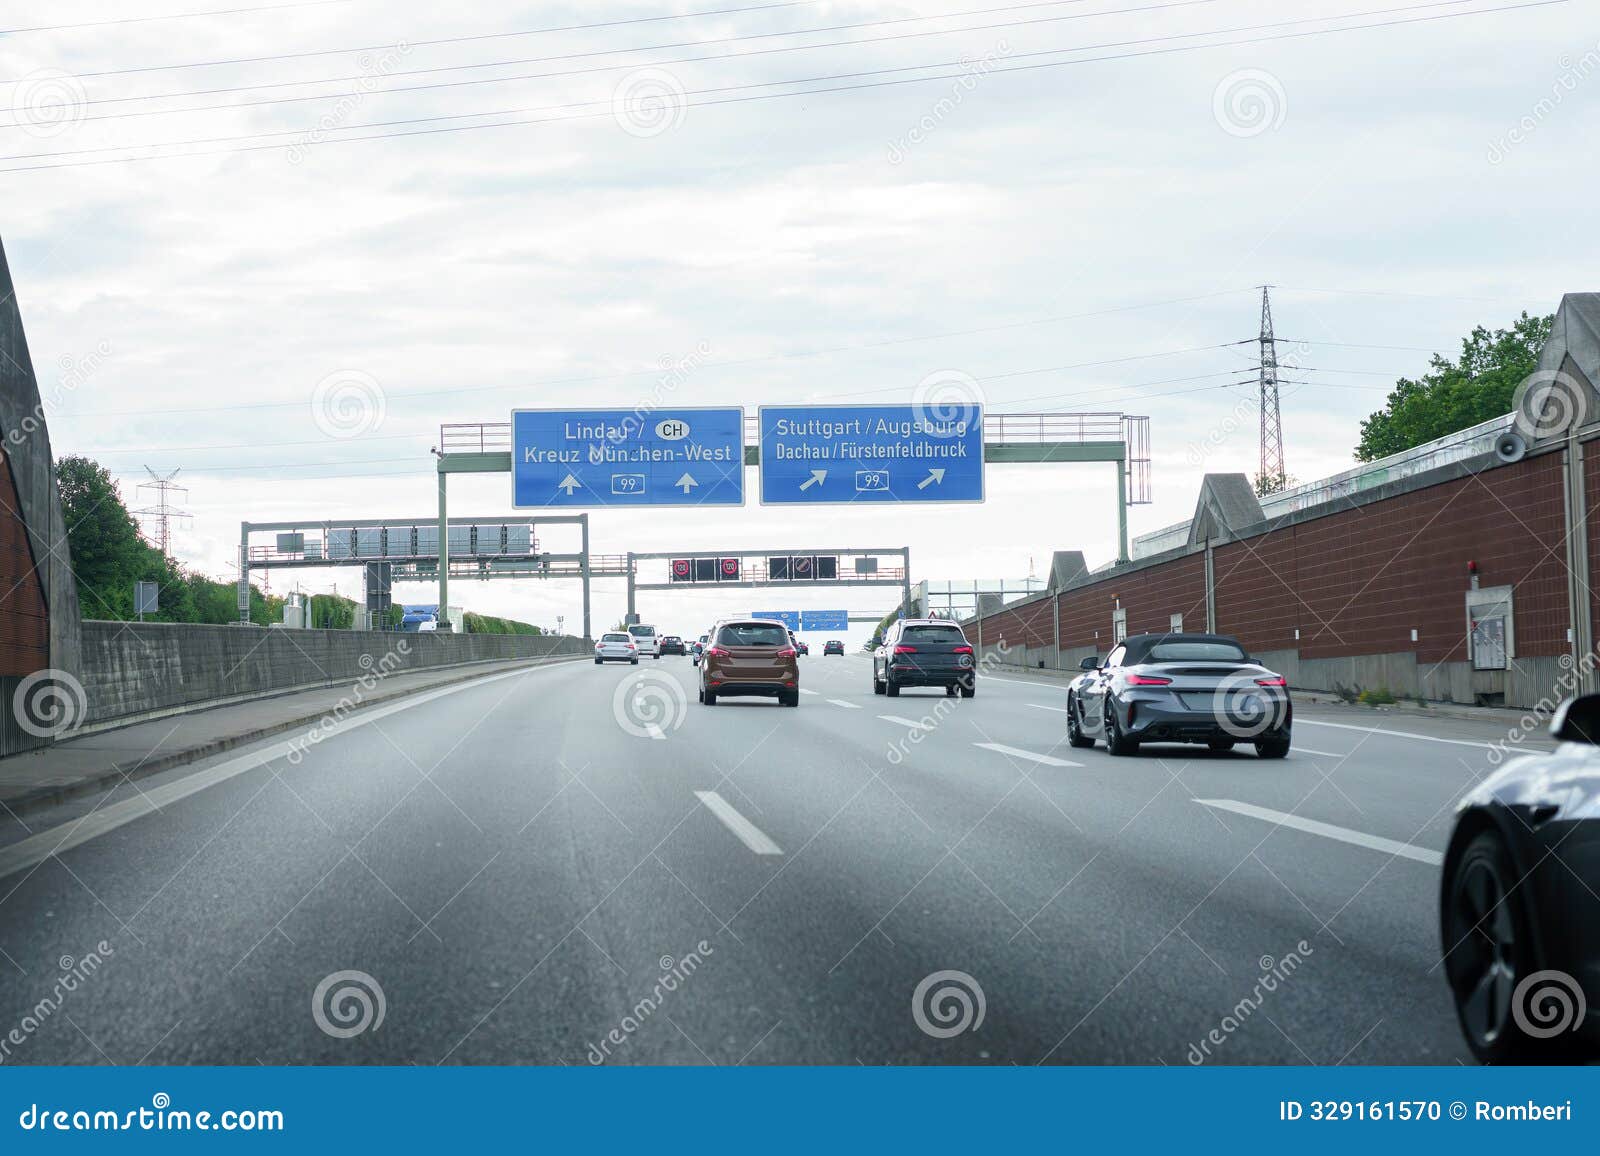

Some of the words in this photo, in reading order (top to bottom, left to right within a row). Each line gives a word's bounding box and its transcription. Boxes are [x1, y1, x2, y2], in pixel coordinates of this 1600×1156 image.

[564, 422, 629, 439] Lindau
[662, 423, 682, 436] CH
[777, 418, 861, 439] Stuttgart
[874, 417, 967, 439] Augsburg
[524, 447, 580, 463] Kreuz
[776, 443, 830, 460] Dachau
[841, 440, 967, 459] Fürstenfeldbruck
[620, 478, 636, 491] 99
[864, 474, 880, 488] 99
